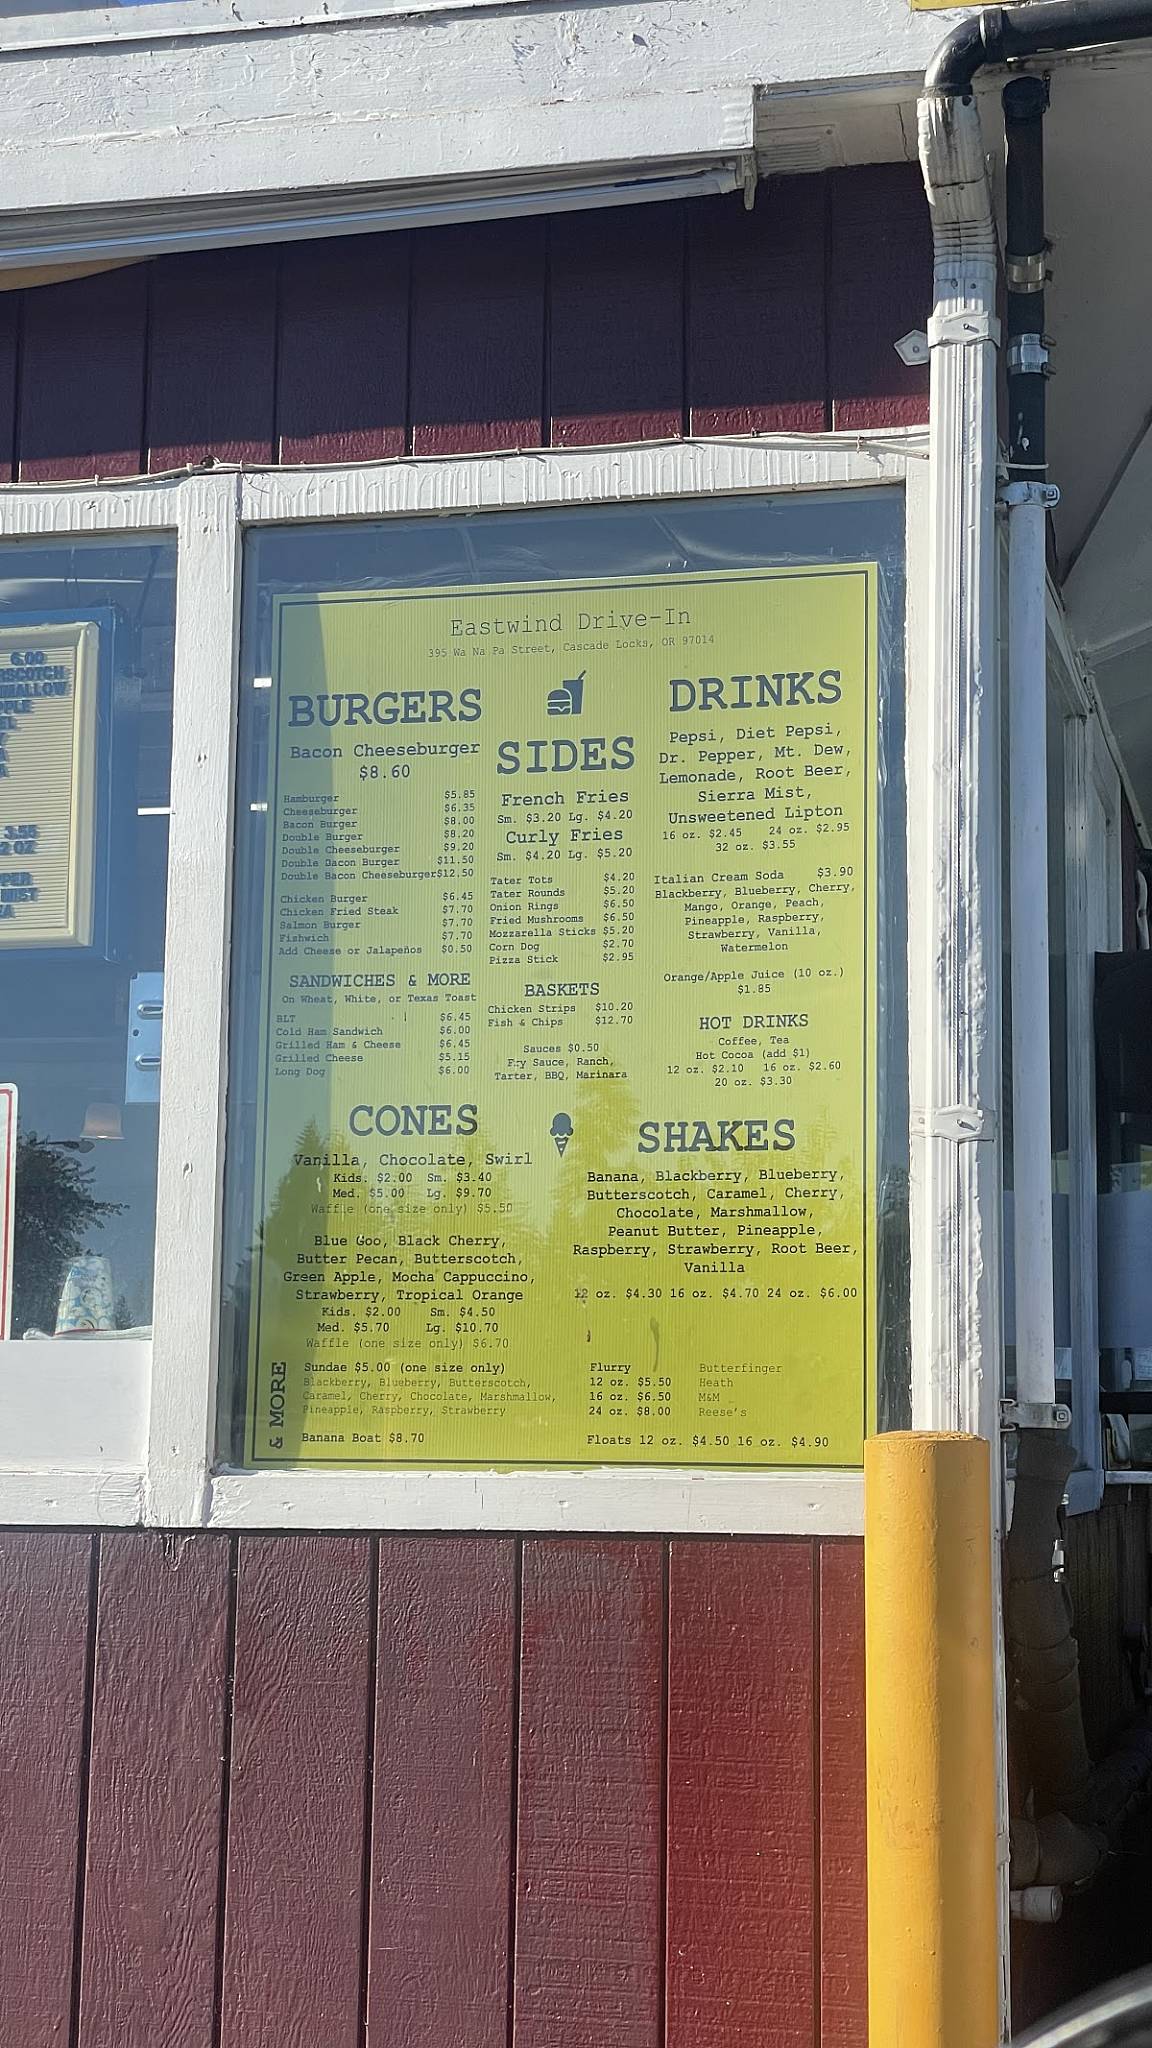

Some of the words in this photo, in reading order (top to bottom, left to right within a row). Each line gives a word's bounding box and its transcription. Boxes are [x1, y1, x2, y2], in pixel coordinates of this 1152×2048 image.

[450, 613, 563, 636] Eastwind
[578, 608, 691, 631] Drive-In
[428, 647, 447, 658] 395
[453, 648, 466, 657] Wa
[472, 646, 485, 656] Na
[492, 646, 504, 655] Pa
[511, 644, 559, 654] Street,
[563, 640, 609, 652] Cascade
[616, 639, 657, 652] Locks,
[662, 637, 675, 646] OR
[682, 634, 714, 647] 97014
[669, 670, 841, 712] DRINKS
[288, 688, 482, 727] BURGERS
[669, 729, 723, 746] Pepsi,
[736, 726, 775, 740] Diet
[786, 725, 840, 740] Pepsi,
[290, 746, 343, 758] Bacon
[354, 742, 480, 758] Cheeseburger
[497, 736, 634, 775] SIDES
[659, 752, 685, 764] Dr.
[698, 750, 762, 765] Pepper,
[774, 746, 801, 758] Mt.
[814, 743, 850, 760] Dew,
[359, 764, 410, 781] $8.60
[659, 769, 743, 784] Lemonade,
[756, 766, 795, 779] Root
[804, 765, 850, 780] Beer,
[284, 794, 340, 805] Hamburger
[444, 790, 475, 799] $5.85
[501, 791, 565, 807] French
[576, 791, 629, 804] Fries
[698, 790, 755, 802] Sierra
[764, 786, 811, 803] Mist,
[283, 806, 358, 817] Cheeseburger
[444, 803, 475, 813] $6.35
[497, 814, 516, 824] Sm.
[526, 812, 561, 824] $3.20
[569, 812, 588, 824] Lg.
[597, 809, 632, 822] $4.20
[668, 807, 775, 824] Unsweetened
[785, 805, 843, 821] Lipton
[283, 821, 314, 829] Bacon
[320, 820, 358, 830] Burger
[444, 816, 475, 826] $8.00
[282, 833, 320, 842] Double
[326, 833, 363, 843] Burger
[444, 829, 474, 839] $8.20
[506, 829, 559, 847] Curly
[570, 829, 623, 841] Fries
[663, 830, 675, 840] 16
[709, 828, 742, 839] $2.45
[769, 826, 781, 835] 24
[816, 822, 850, 834] $2.95
[497, 852, 516, 861] Sm.
[526, 849, 561, 861] $4.20
[568, 850, 587, 861] Lg.
[597, 847, 632, 859] $5.20
[489, 928, 552, 938] Mozzarella
[559, 927, 596, 936] Sticks
[603, 925, 634, 936] $5.20
[290, 974, 395, 987] SANDWICHES
[408, 974, 417, 986] &
[427, 973, 470, 986] MORE
[524, 982, 599, 997] BASKETS
[488, 1004, 532, 1014] Chicken
[538, 1004, 576, 1015] Strips
[595, 1002, 633, 1012] $10.20
[699, 1016, 732, 1030] HOT
[743, 1014, 808, 1029] DRINKS
[718, 1036, 761, 1046] Coffee,
[770, 1036, 789, 1044] Tea
[696, 1052, 716, 1060] Hot
[721, 1051, 754, 1059] Cocoa
[762, 1048, 786, 1060] (add
[793, 1048, 809, 1059] $1)
[668, 1065, 679, 1074] 12
[712, 1063, 744, 1074] $2.10
[764, 1063, 776, 1072] 16
[809, 1060, 841, 1072] $2.60
[349, 1104, 478, 1136] CONES
[638, 1119, 795, 1153] SHAKES
[294, 1153, 367, 1168] Vanilla,
[379, 1153, 472, 1167] Chocolate,
[485, 1152, 532, 1165] Swirl
[333, 1173, 367, 1183] Kids.
[377, 1172, 412, 1184] $2.00
[427, 1173, 447, 1182] Sm.
[456, 1172, 492, 1183] $3.40
[587, 1172, 644, 1184] Banana,
[656, 1169, 748, 1184] Blackberry,
[758, 1168, 843, 1182] Blueberry,
[333, 1188, 360, 1198] Med.
[370, 1188, 405, 1198] $5.00
[427, 1188, 446, 1200] Lg.
[456, 1187, 491, 1199] $9.70
[587, 1188, 696, 1201] Butterscotch,
[707, 1187, 774, 1200] Caramel,
[785, 1187, 843, 1201] Cherry,
[617, 1207, 700, 1220] Chocolate,
[710, 1205, 813, 1218] Marshmallow,
[608, 1226, 659, 1237] Peanut
[667, 1225, 725, 1238] Butter,
[737, 1224, 821, 1239] Pineapple,
[314, 1235, 347, 1246] Blue
[356, 1235, 387, 1248] Goo,
[398, 1234, 440, 1246] Black
[449, 1235, 505, 1249] Cherry,
[573, 1243, 656, 1258] Raspberry,
[668, 1243, 760, 1257] Strawberry,
[771, 1243, 807, 1254] Root
[815, 1243, 856, 1255] Beer,
[297, 1253, 347, 1264] Butter
[356, 1253, 403, 1266] Pecan,
[414, 1252, 522, 1266] Butterscotch,
[684, 1261, 745, 1273] Vanilla
[284, 1271, 325, 1282] Green
[333, 1271, 381, 1285] Apple,
[392, 1271, 435, 1282] Mocha
[443, 1271, 534, 1285] Cappuccino,
[296, 1289, 385, 1303] Strawberry,
[396, 1289, 463, 1303] Tropical
[472, 1289, 523, 1303] Orange
[304, 1362, 347, 1372] Sundae
[355, 1361, 390, 1374] $5.00
[401, 1362, 427, 1374] (one
[435, 1362, 463, 1372] size
[470, 1362, 504, 1375] only)
[590, 1362, 631, 1374] Flurry
[699, 1363, 783, 1375] Butterfinger
[699, 1377, 733, 1387] Heath
[269, 1361, 286, 1427] MORE
[269, 1437, 283, 1449] &
[301, 1433, 345, 1442] Banana
[352, 1433, 381, 1443] Boat
[389, 1432, 424, 1444] $8.70
[587, 1434, 631, 1445] Floats
[640, 1435, 653, 1445] 12
[661, 1437, 682, 1445] oz.
[692, 1434, 729, 1447] $4.50
[738, 1436, 752, 1446] 16
[760, 1439, 780, 1447] oz.
[791, 1436, 828, 1448] $4.90
